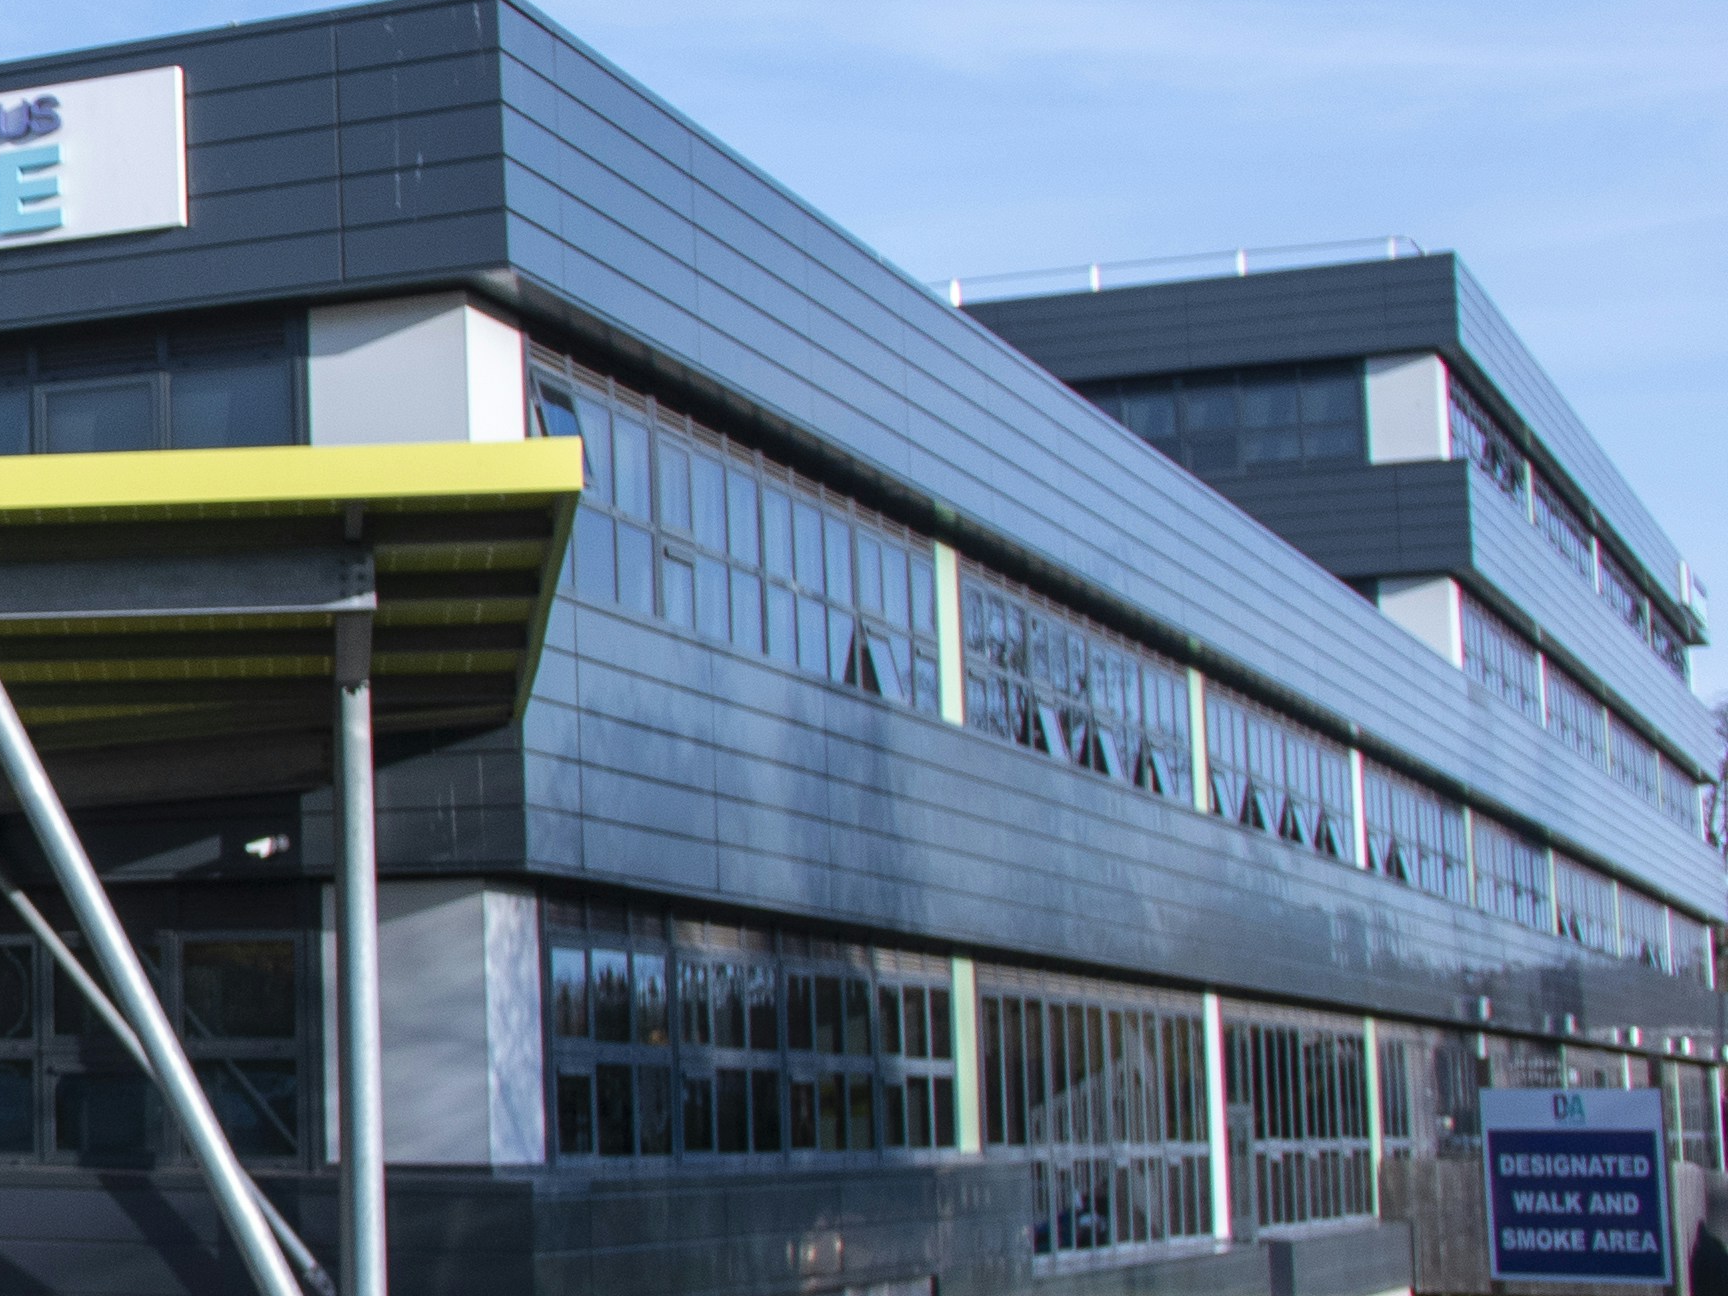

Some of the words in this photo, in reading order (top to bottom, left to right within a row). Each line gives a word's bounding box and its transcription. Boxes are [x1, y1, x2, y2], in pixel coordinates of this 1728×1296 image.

[1499, 1153, 1651, 1178] DESIGNATED
[1512, 1190, 1583, 1214] WALK
[1589, 1191, 1640, 1216] AND
[1501, 1227, 1586, 1252] SMOKE
[1592, 1229, 1659, 1253] AREA
